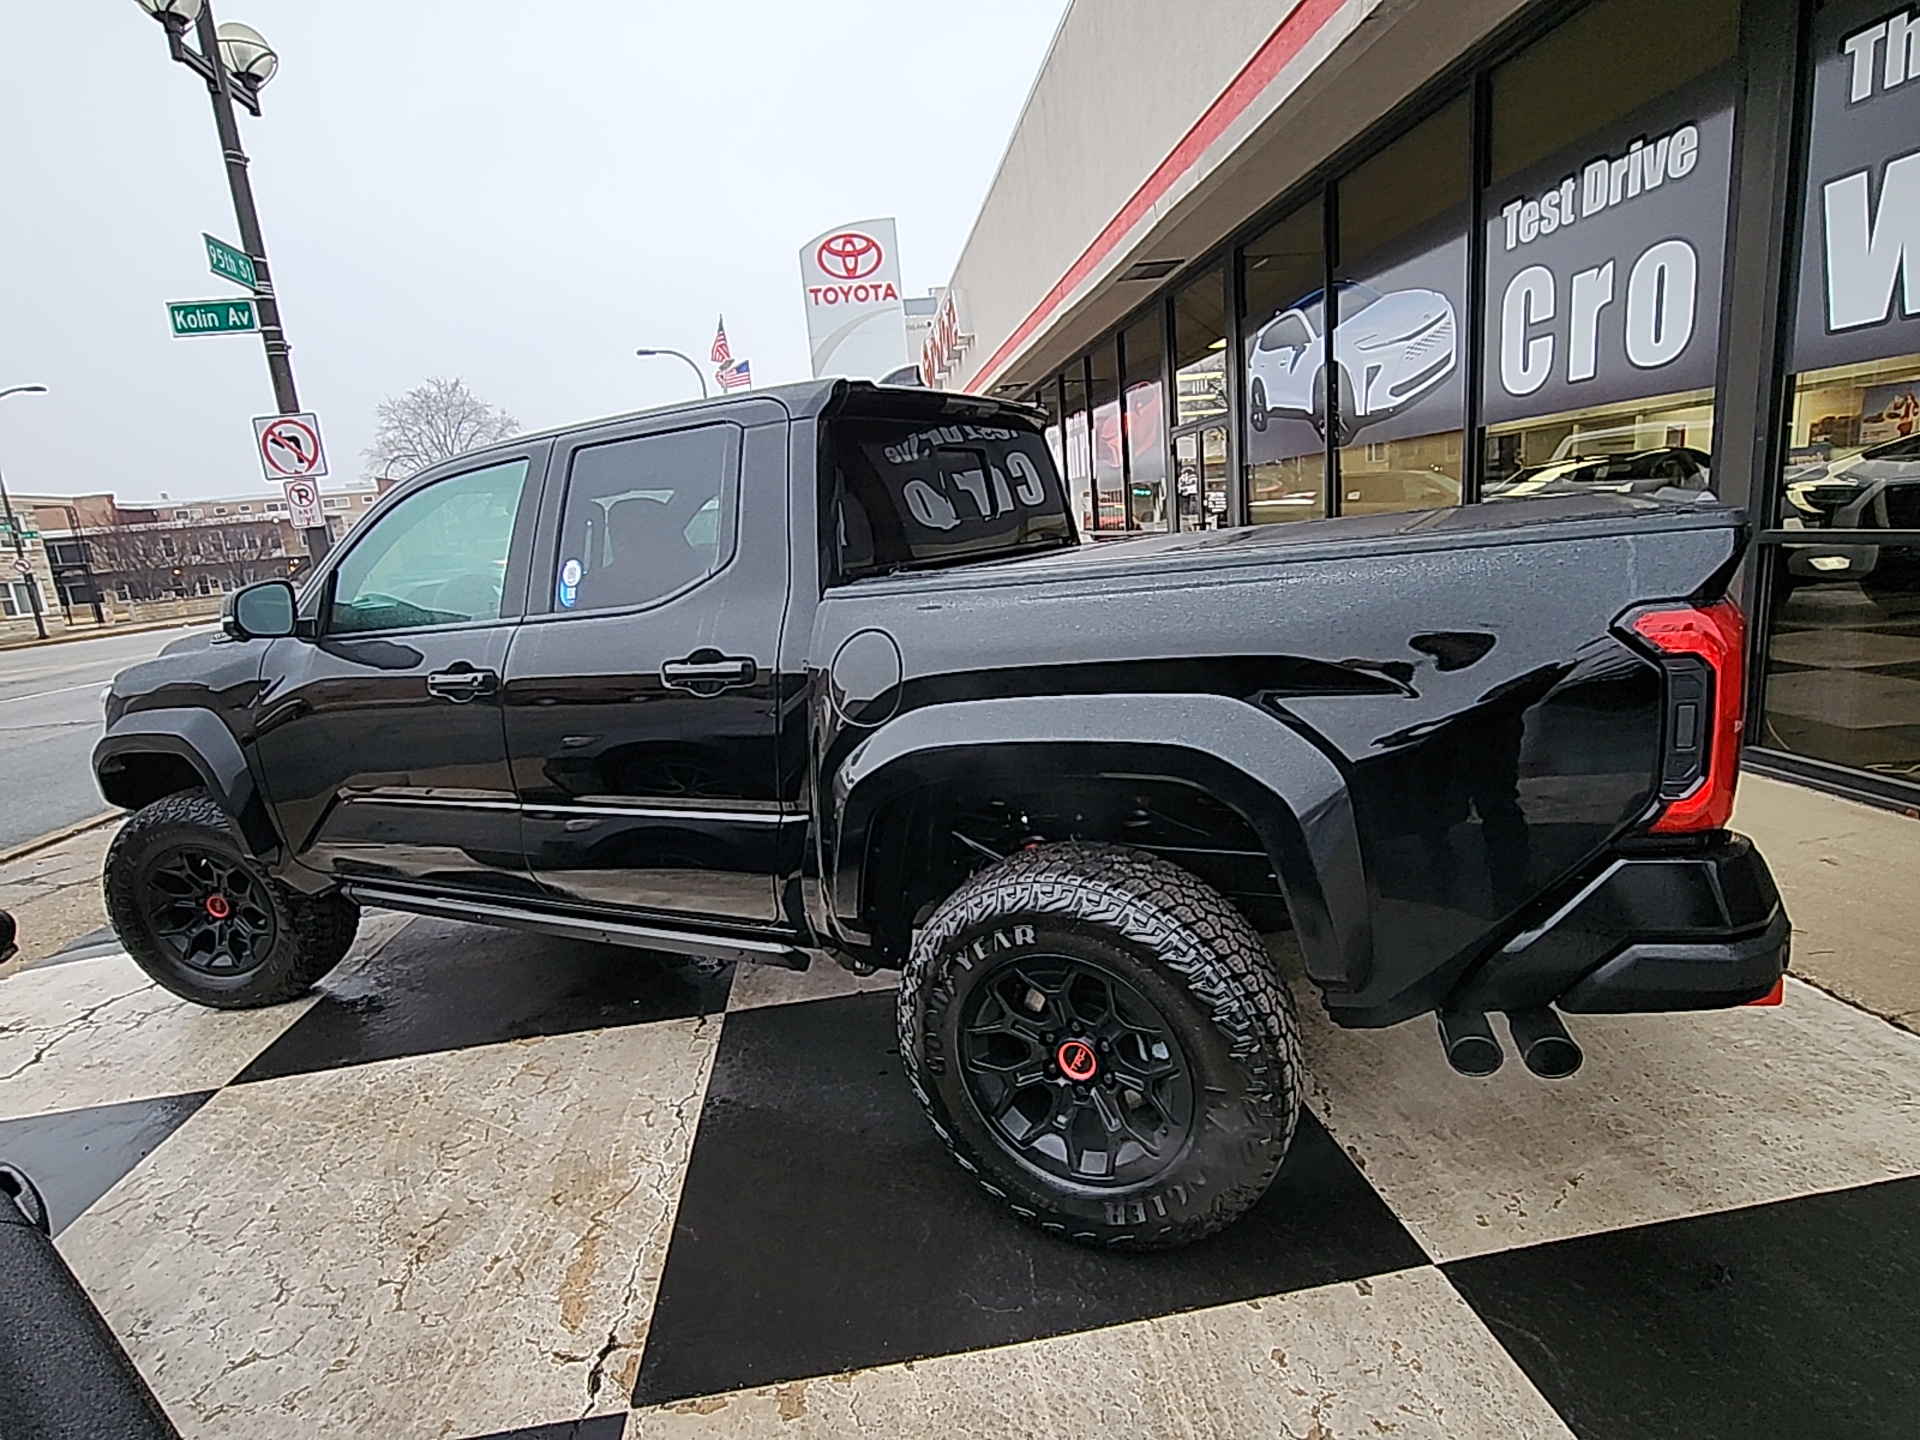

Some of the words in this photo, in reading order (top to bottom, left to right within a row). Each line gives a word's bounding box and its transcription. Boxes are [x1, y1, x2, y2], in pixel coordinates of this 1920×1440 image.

[1502, 176, 1577, 251] Test
[1581, 125, 1699, 219] Drive
[208, 244, 238, 275] 95th
[239, 258, 253, 282] St
[808, 282, 899, 306] TOYOTA
[173, 308, 220, 330] Kolin
[228, 306, 250, 327] Av
